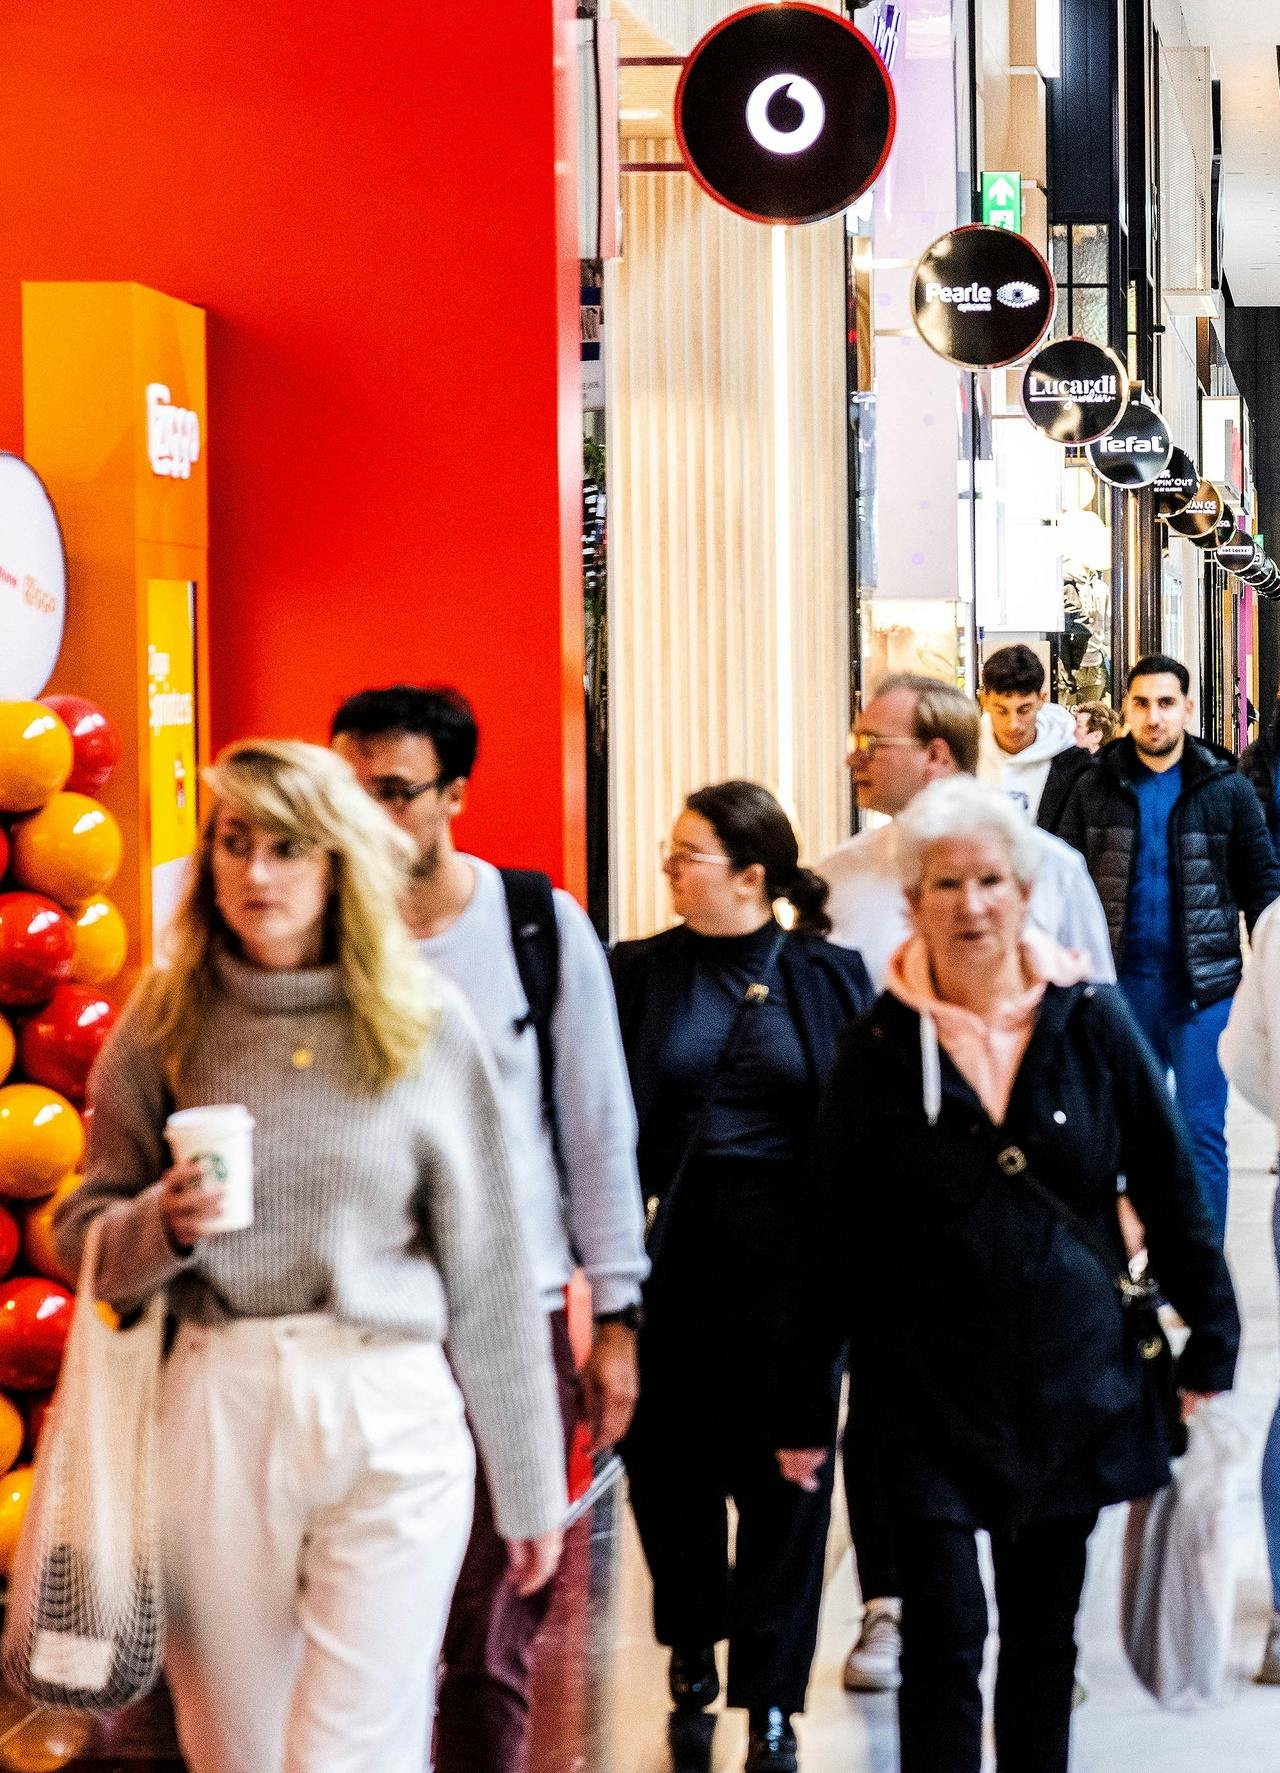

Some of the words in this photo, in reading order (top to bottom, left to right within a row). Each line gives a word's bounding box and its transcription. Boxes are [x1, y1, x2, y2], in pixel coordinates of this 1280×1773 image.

[925, 282, 992, 303] Pearle
[1029, 375, 1116, 396] Lucardi
[1100, 435, 1165, 453] Tefal
